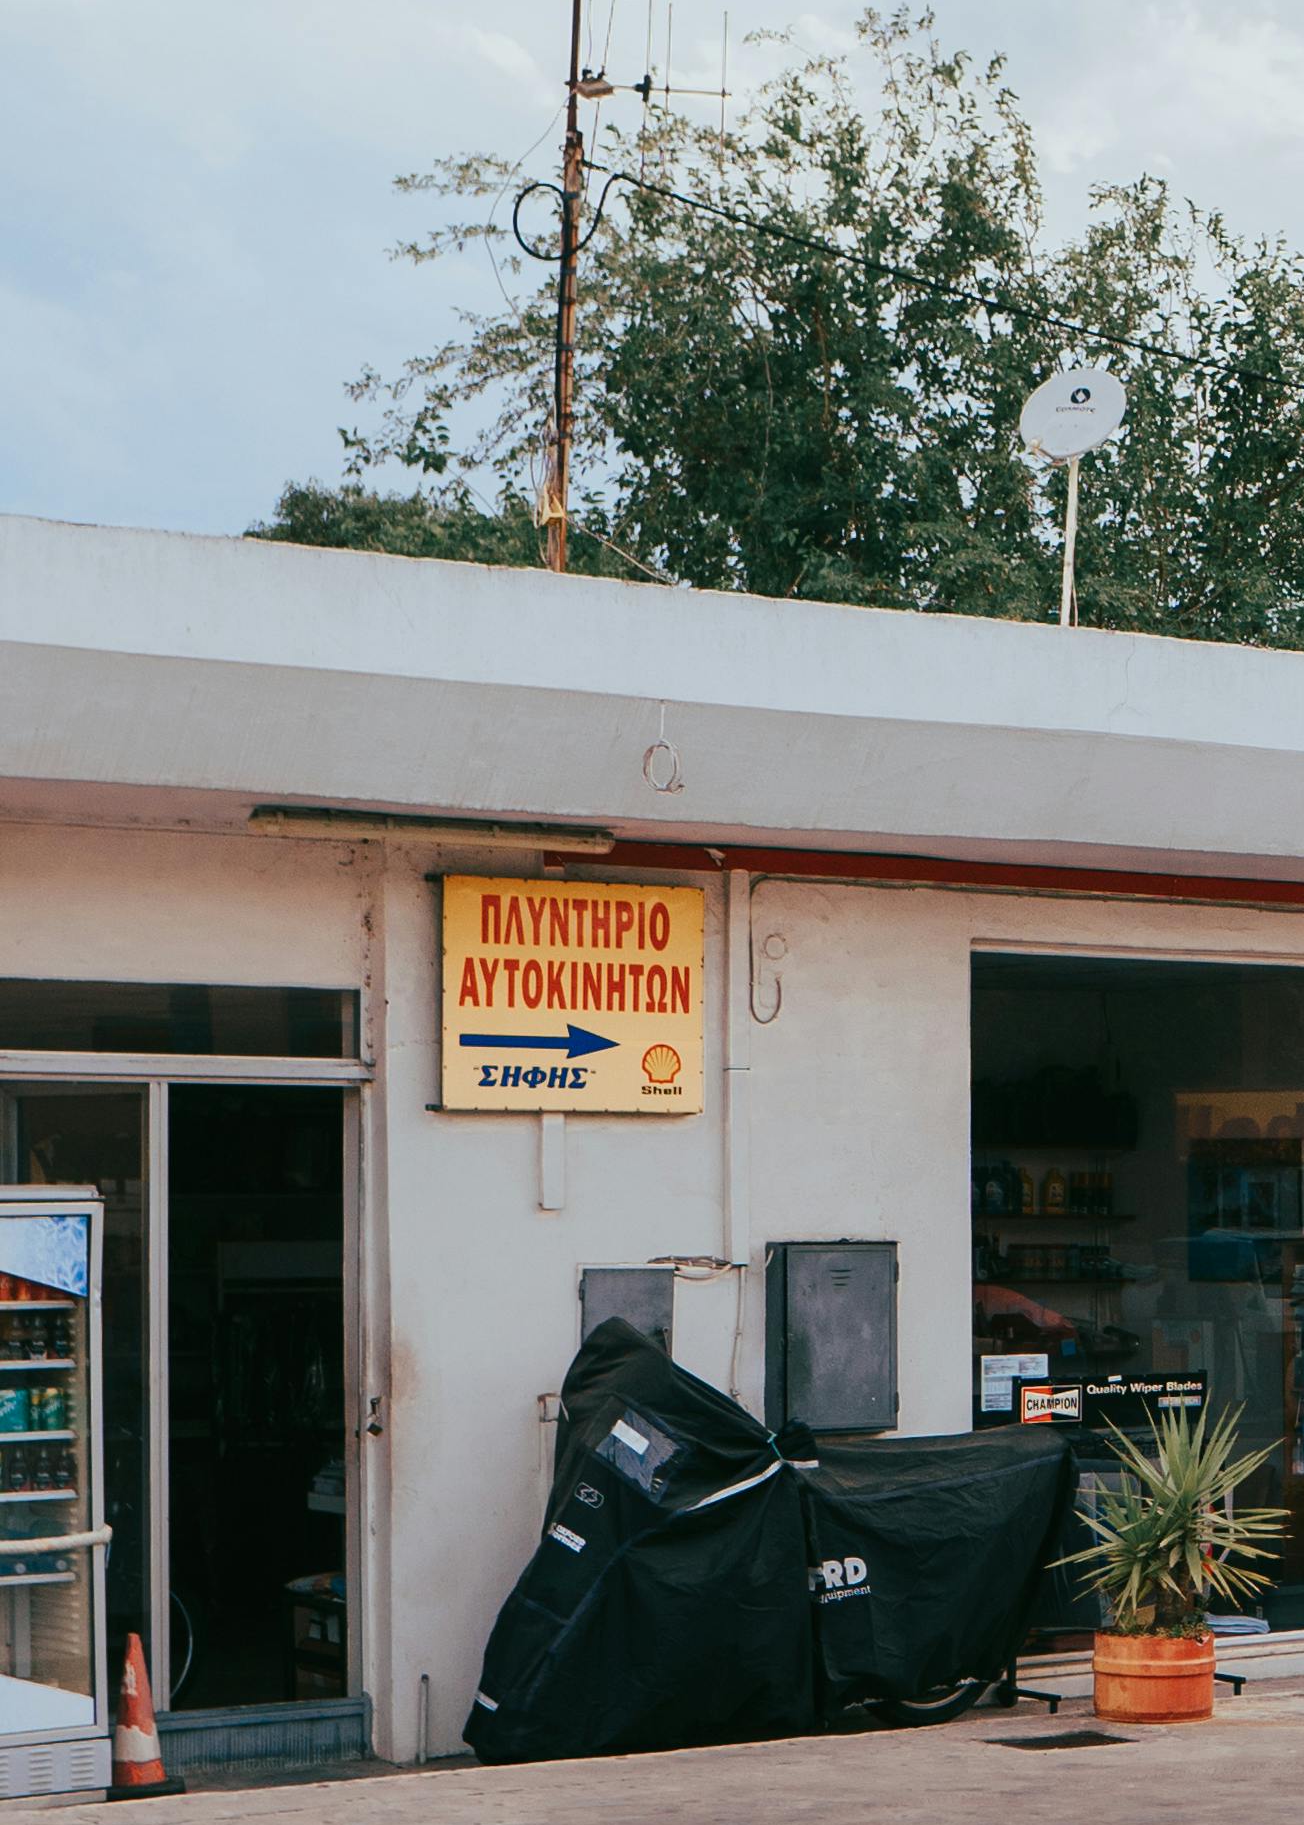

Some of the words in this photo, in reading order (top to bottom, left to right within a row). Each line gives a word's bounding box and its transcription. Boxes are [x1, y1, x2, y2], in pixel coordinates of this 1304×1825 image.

[480, 894, 671, 952] ΠΛΥΝΤΗΡΙΟ
[458, 956, 691, 1015] ΑΥΤΟΚΙΝΗΤΩΝ
[641, 1085, 683, 1096] Shell
[1086, 1383, 1127, 1396] Quality
[1130, 1382, 1164, 1394] Wiper
[1166, 1381, 1203, 1392] Blades
[1026, 1395, 1078, 1411] CHAMPION
